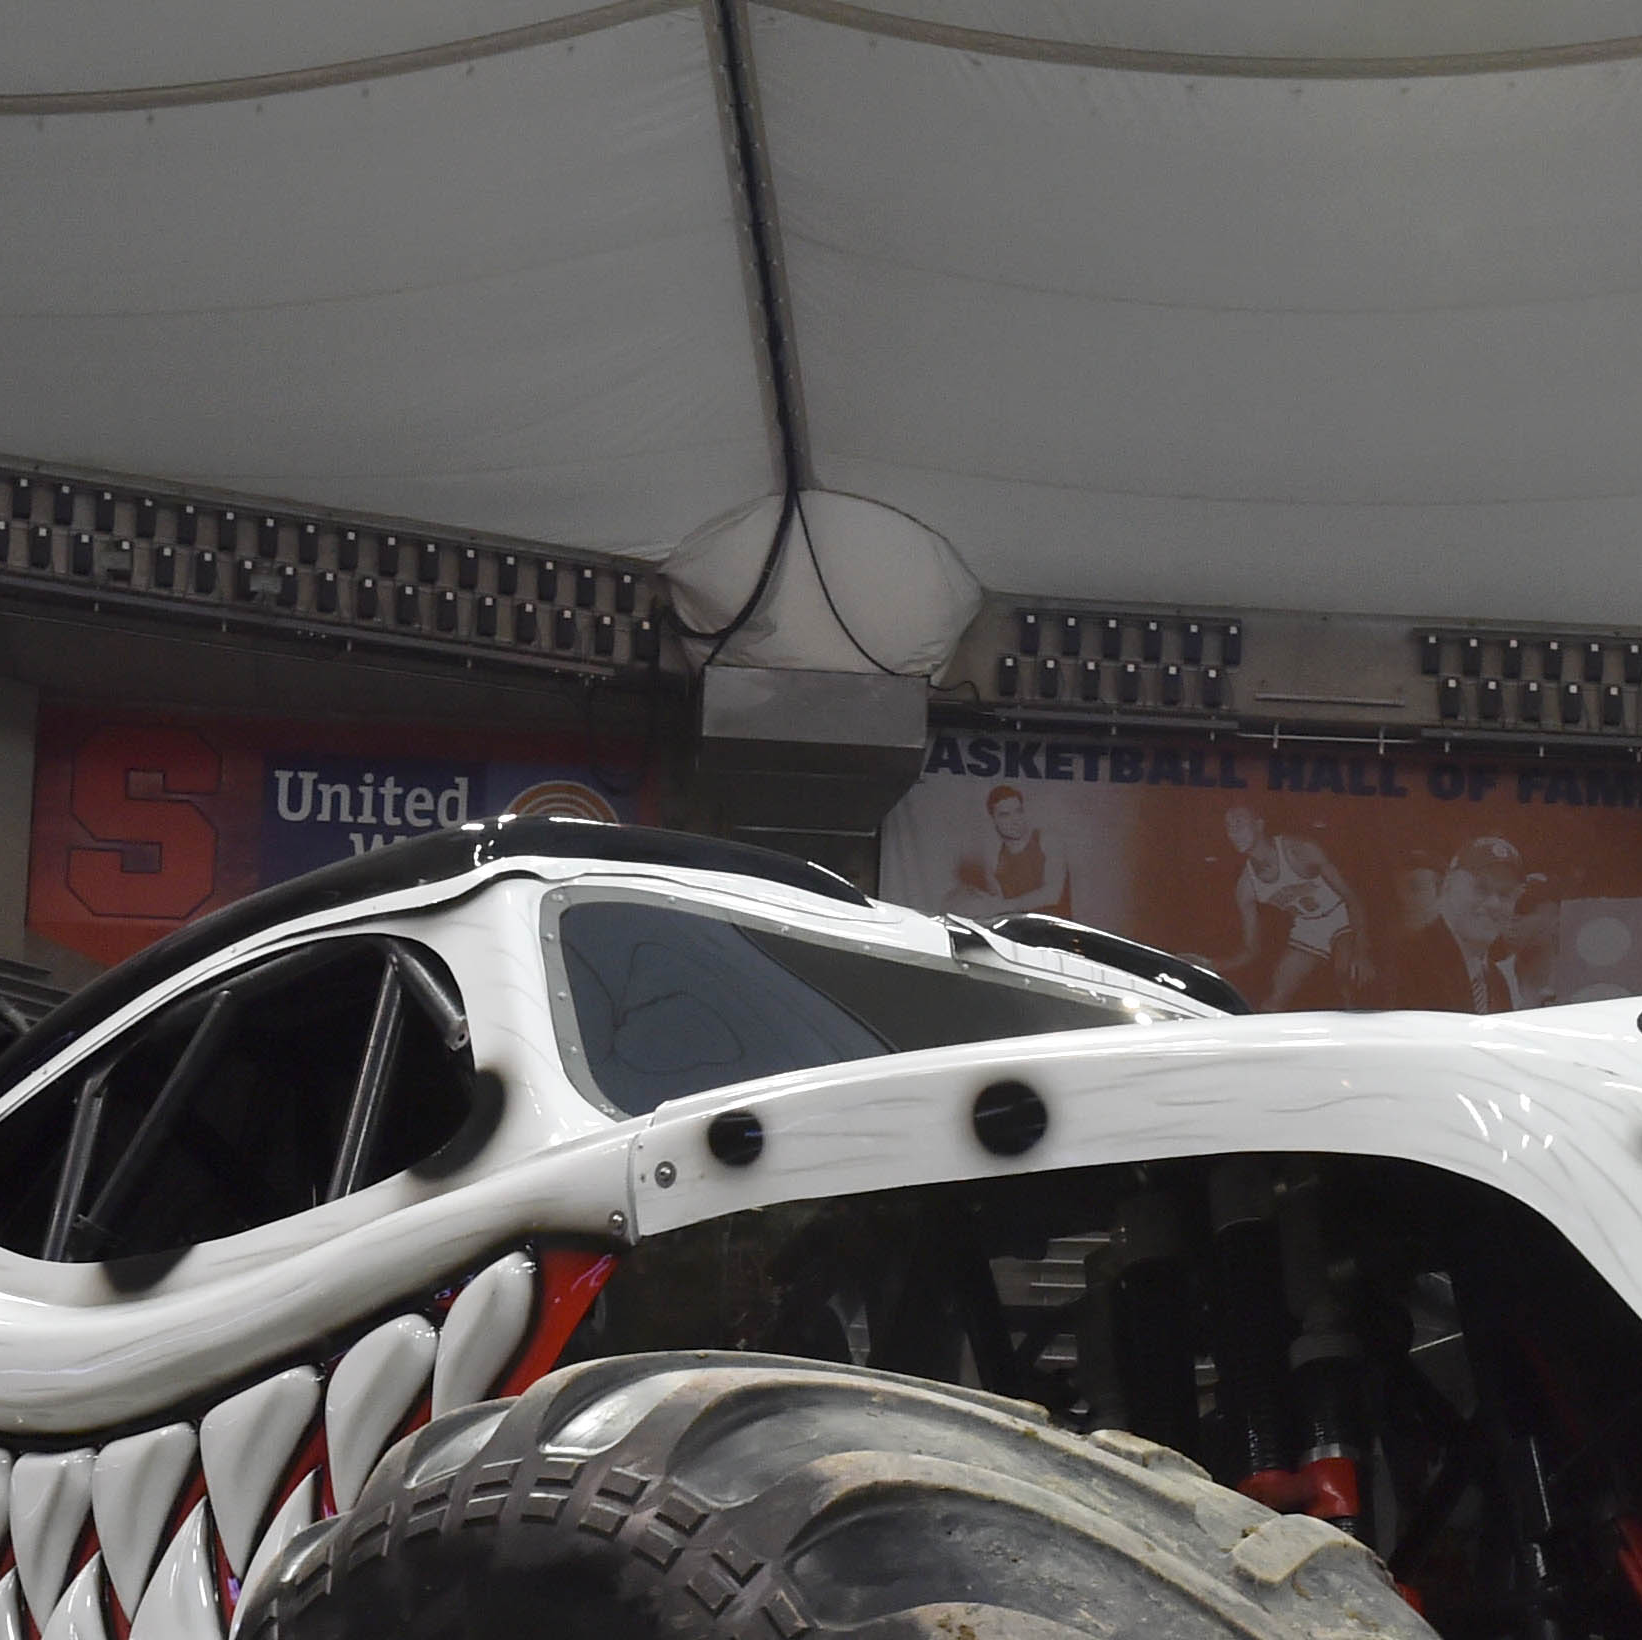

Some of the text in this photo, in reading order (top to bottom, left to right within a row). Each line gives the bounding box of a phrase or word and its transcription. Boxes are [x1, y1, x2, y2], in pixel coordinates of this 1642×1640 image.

[273, 769, 469, 828] United
[1268, 753, 1407, 799] HALL
[1426, 763, 1497, 803] OF
